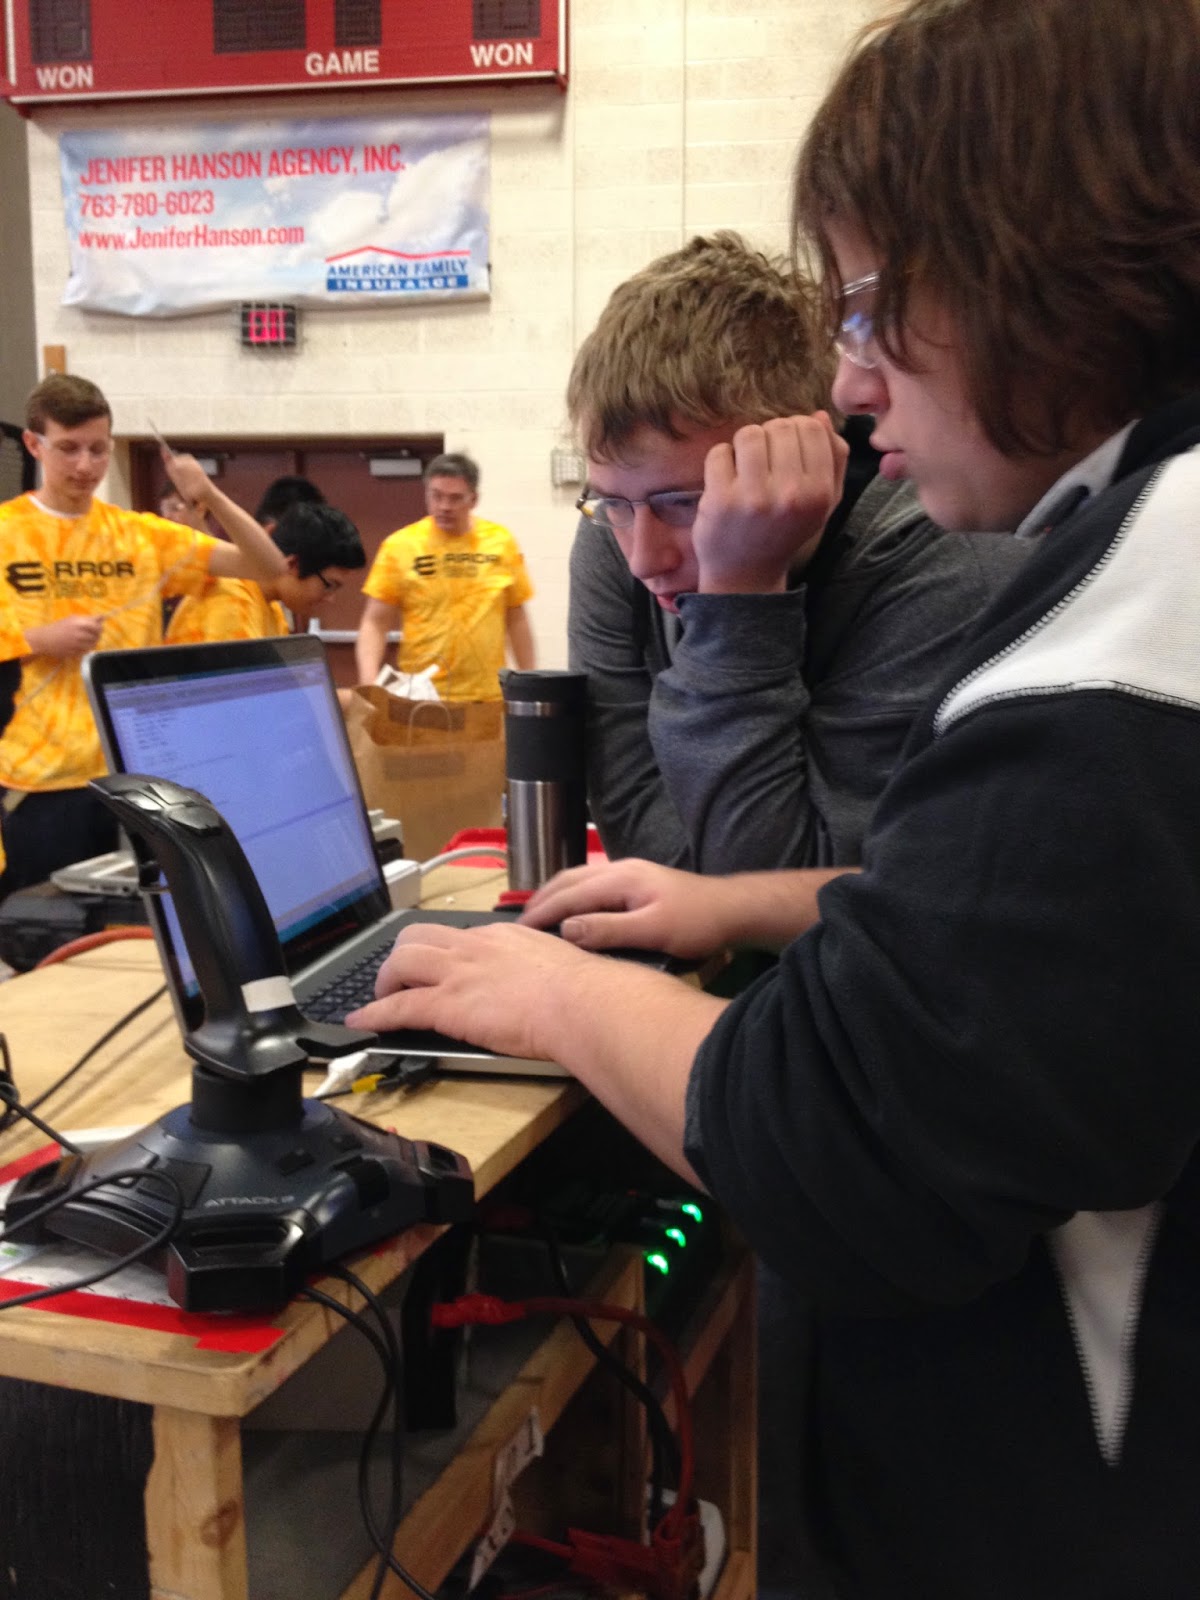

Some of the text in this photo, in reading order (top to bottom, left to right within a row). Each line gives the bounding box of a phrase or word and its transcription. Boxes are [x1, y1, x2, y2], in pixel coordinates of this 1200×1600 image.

[305, 50, 380, 75] GAME
[470, 43, 534, 67] WON
[36, 65, 94, 90] WON
[80, 144, 406, 186] JENIFER HANSON AGENCY, INC.
[79, 190, 215, 218] 763-780-6023
[79, 224, 305, 250] www.JeniferHanson.com
[328, 260, 468, 276] AMERICAN FAMILY
[336, 277, 457, 290] INSURANCE
